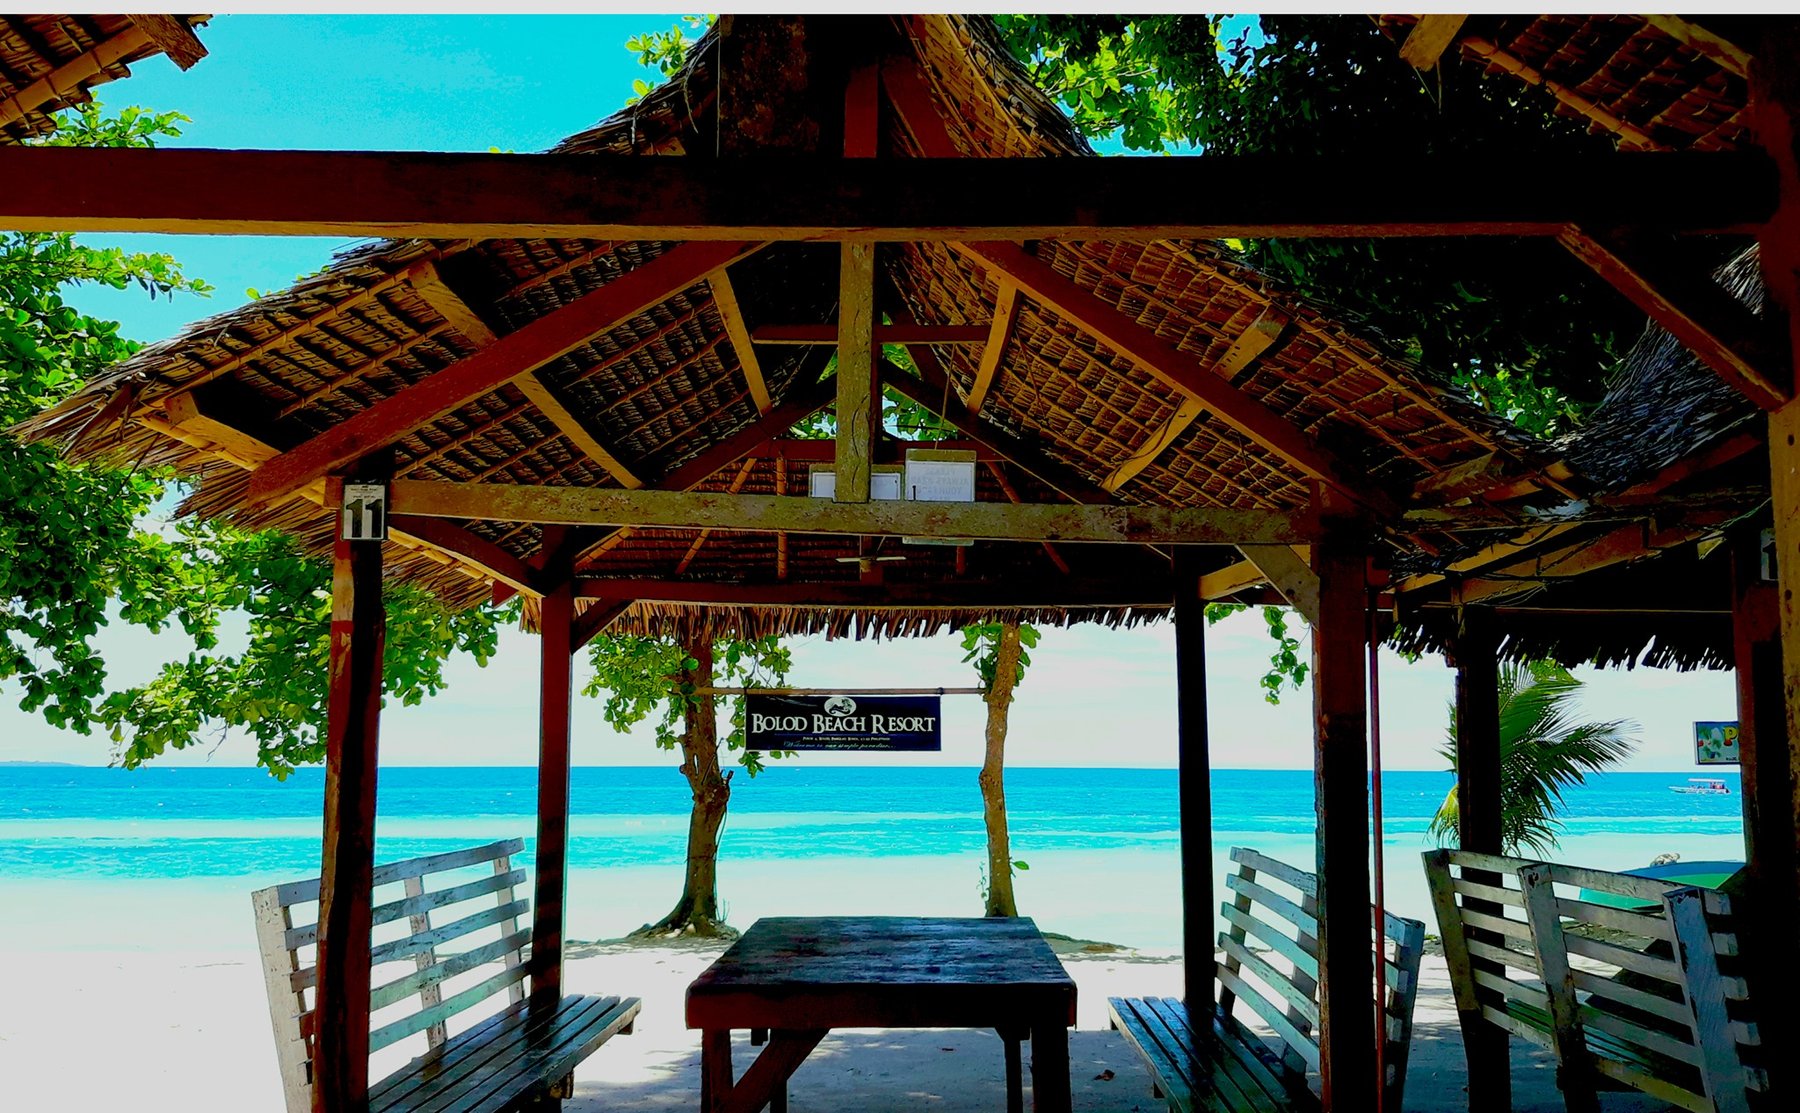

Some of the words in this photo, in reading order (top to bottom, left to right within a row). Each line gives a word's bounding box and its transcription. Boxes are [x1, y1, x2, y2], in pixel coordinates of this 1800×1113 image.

[346, 499, 383, 538] 11
[752, 713, 808, 734] BOLOD
[812, 713, 866, 734] BEACH
[870, 713, 936, 733] RESORT
